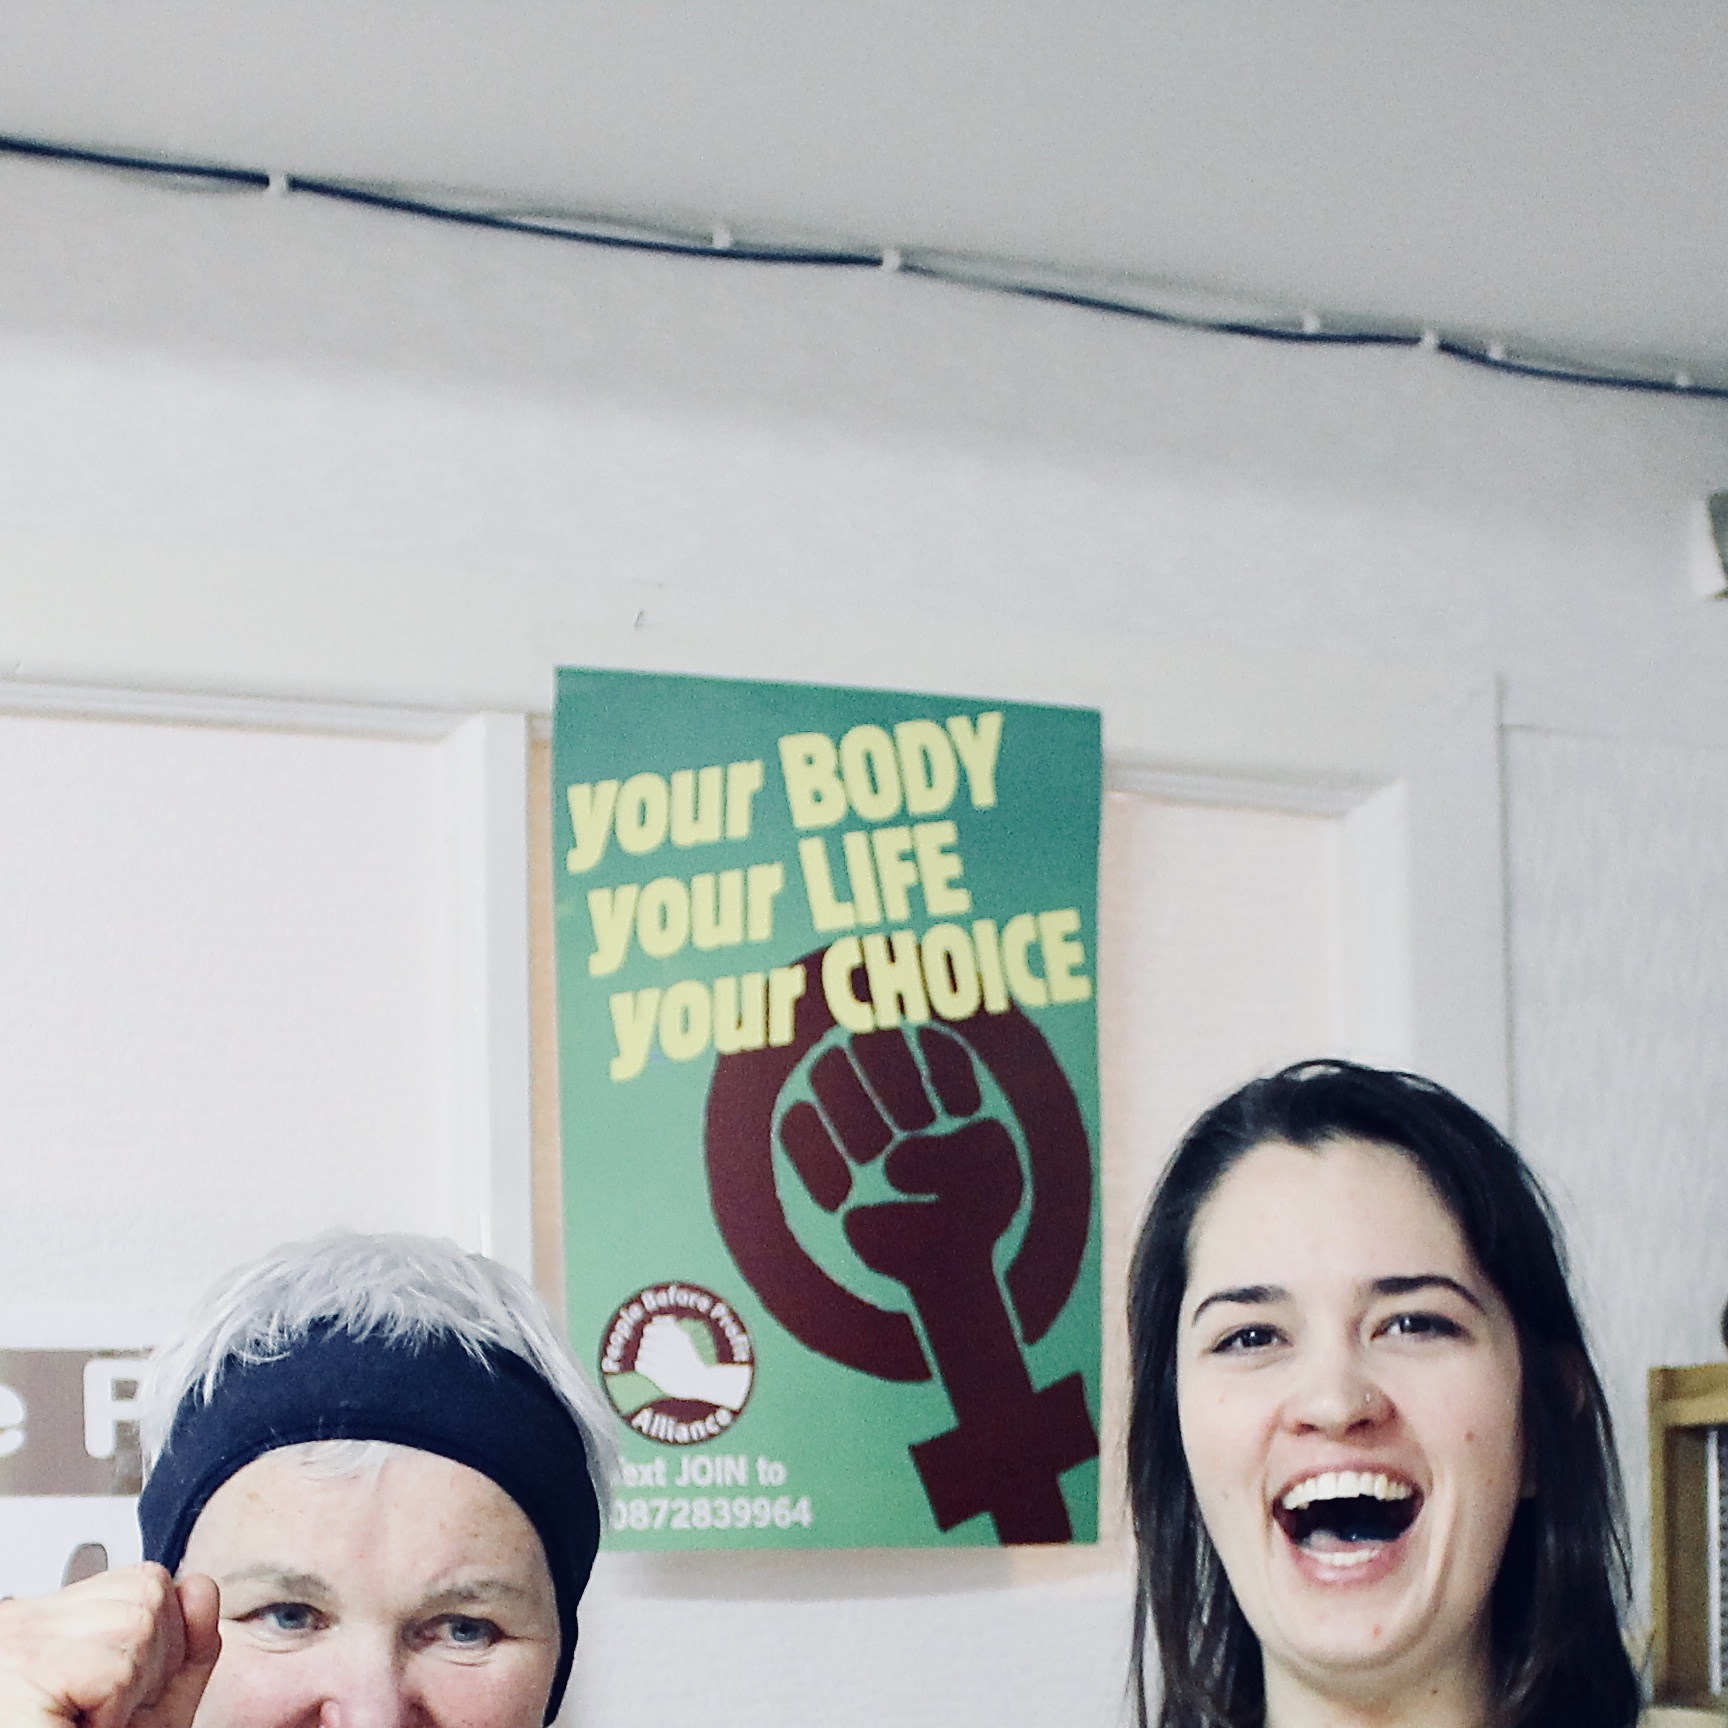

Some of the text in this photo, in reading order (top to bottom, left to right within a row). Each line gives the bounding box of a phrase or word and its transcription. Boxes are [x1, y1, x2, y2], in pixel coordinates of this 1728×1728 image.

[566, 711, 1003, 873] your BODY
[588, 820, 970, 976] your LIFE
[609, 908, 1092, 1082] your CHOICE
[618, 1454, 787, 1488] ext JOIN to
[630, 1407, 734, 1444] Alliance
